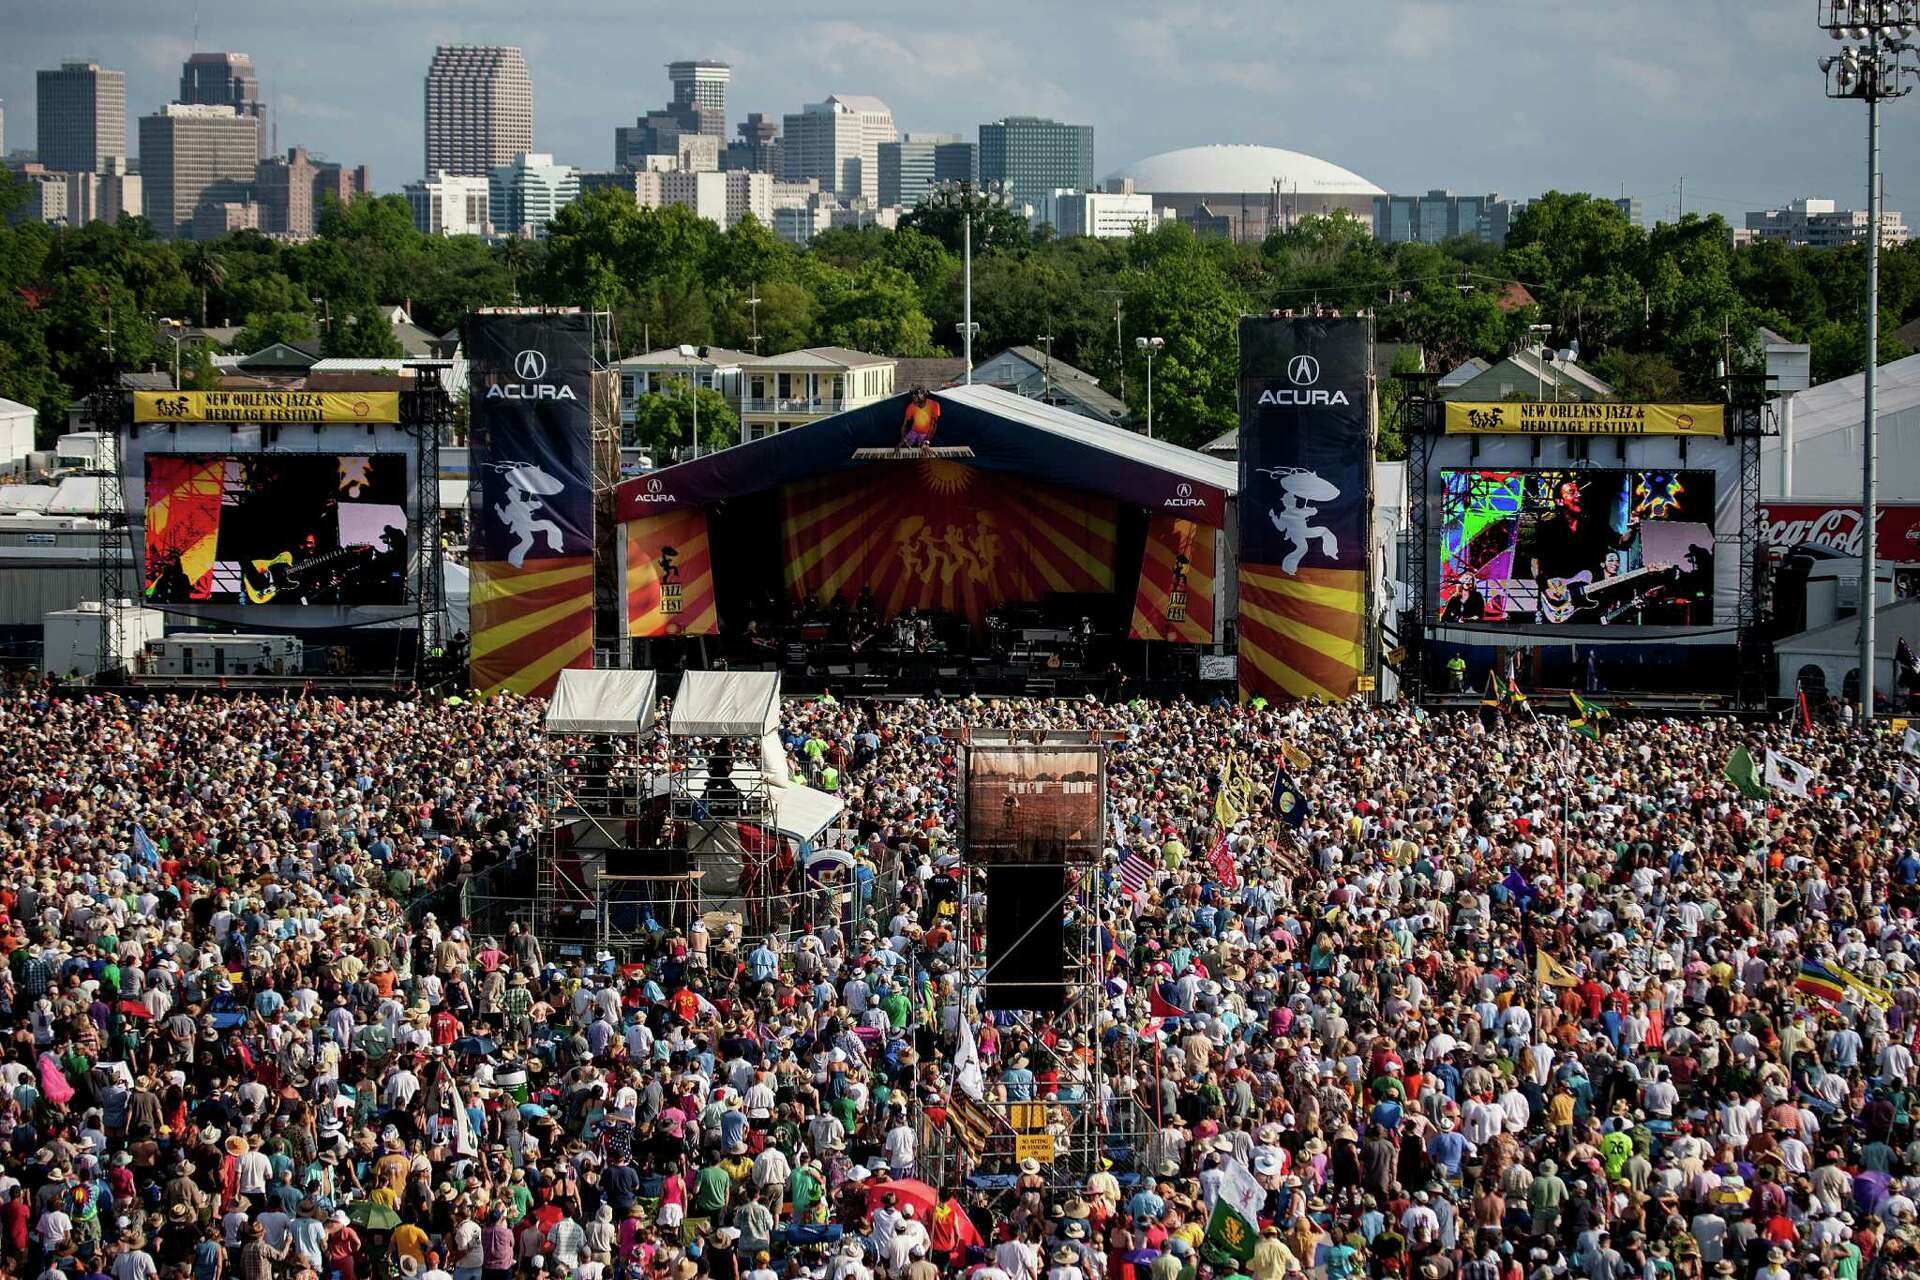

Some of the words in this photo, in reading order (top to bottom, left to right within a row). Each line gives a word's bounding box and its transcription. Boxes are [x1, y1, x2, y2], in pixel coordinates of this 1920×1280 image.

[486, 383, 577, 400] ACURA
[1257, 389, 1350, 406] ACURA
[206, 393, 229, 406] NEW
[232, 393, 282, 406] ORLEANS
[286, 393, 312, 406] JAZZ
[205, 408, 263, 421] HERITAGE
[270, 408, 323, 421] FESTIVAL
[1521, 404, 1547, 418] NEW
[1549, 404, 1602, 418] ORLEANS
[1605, 405, 1633, 420] JAZZ
[1636, 406, 1645, 419] &
[1520, 420, 1585, 433] HERITAGE
[1589, 420, 1644, 433] FESTIVAL
[634, 494, 676, 502] ACURA
[1163, 498, 1206, 507] ACURA
[661, 598, 681, 612] FEST
[1610, 1140, 1625, 1155] 26
